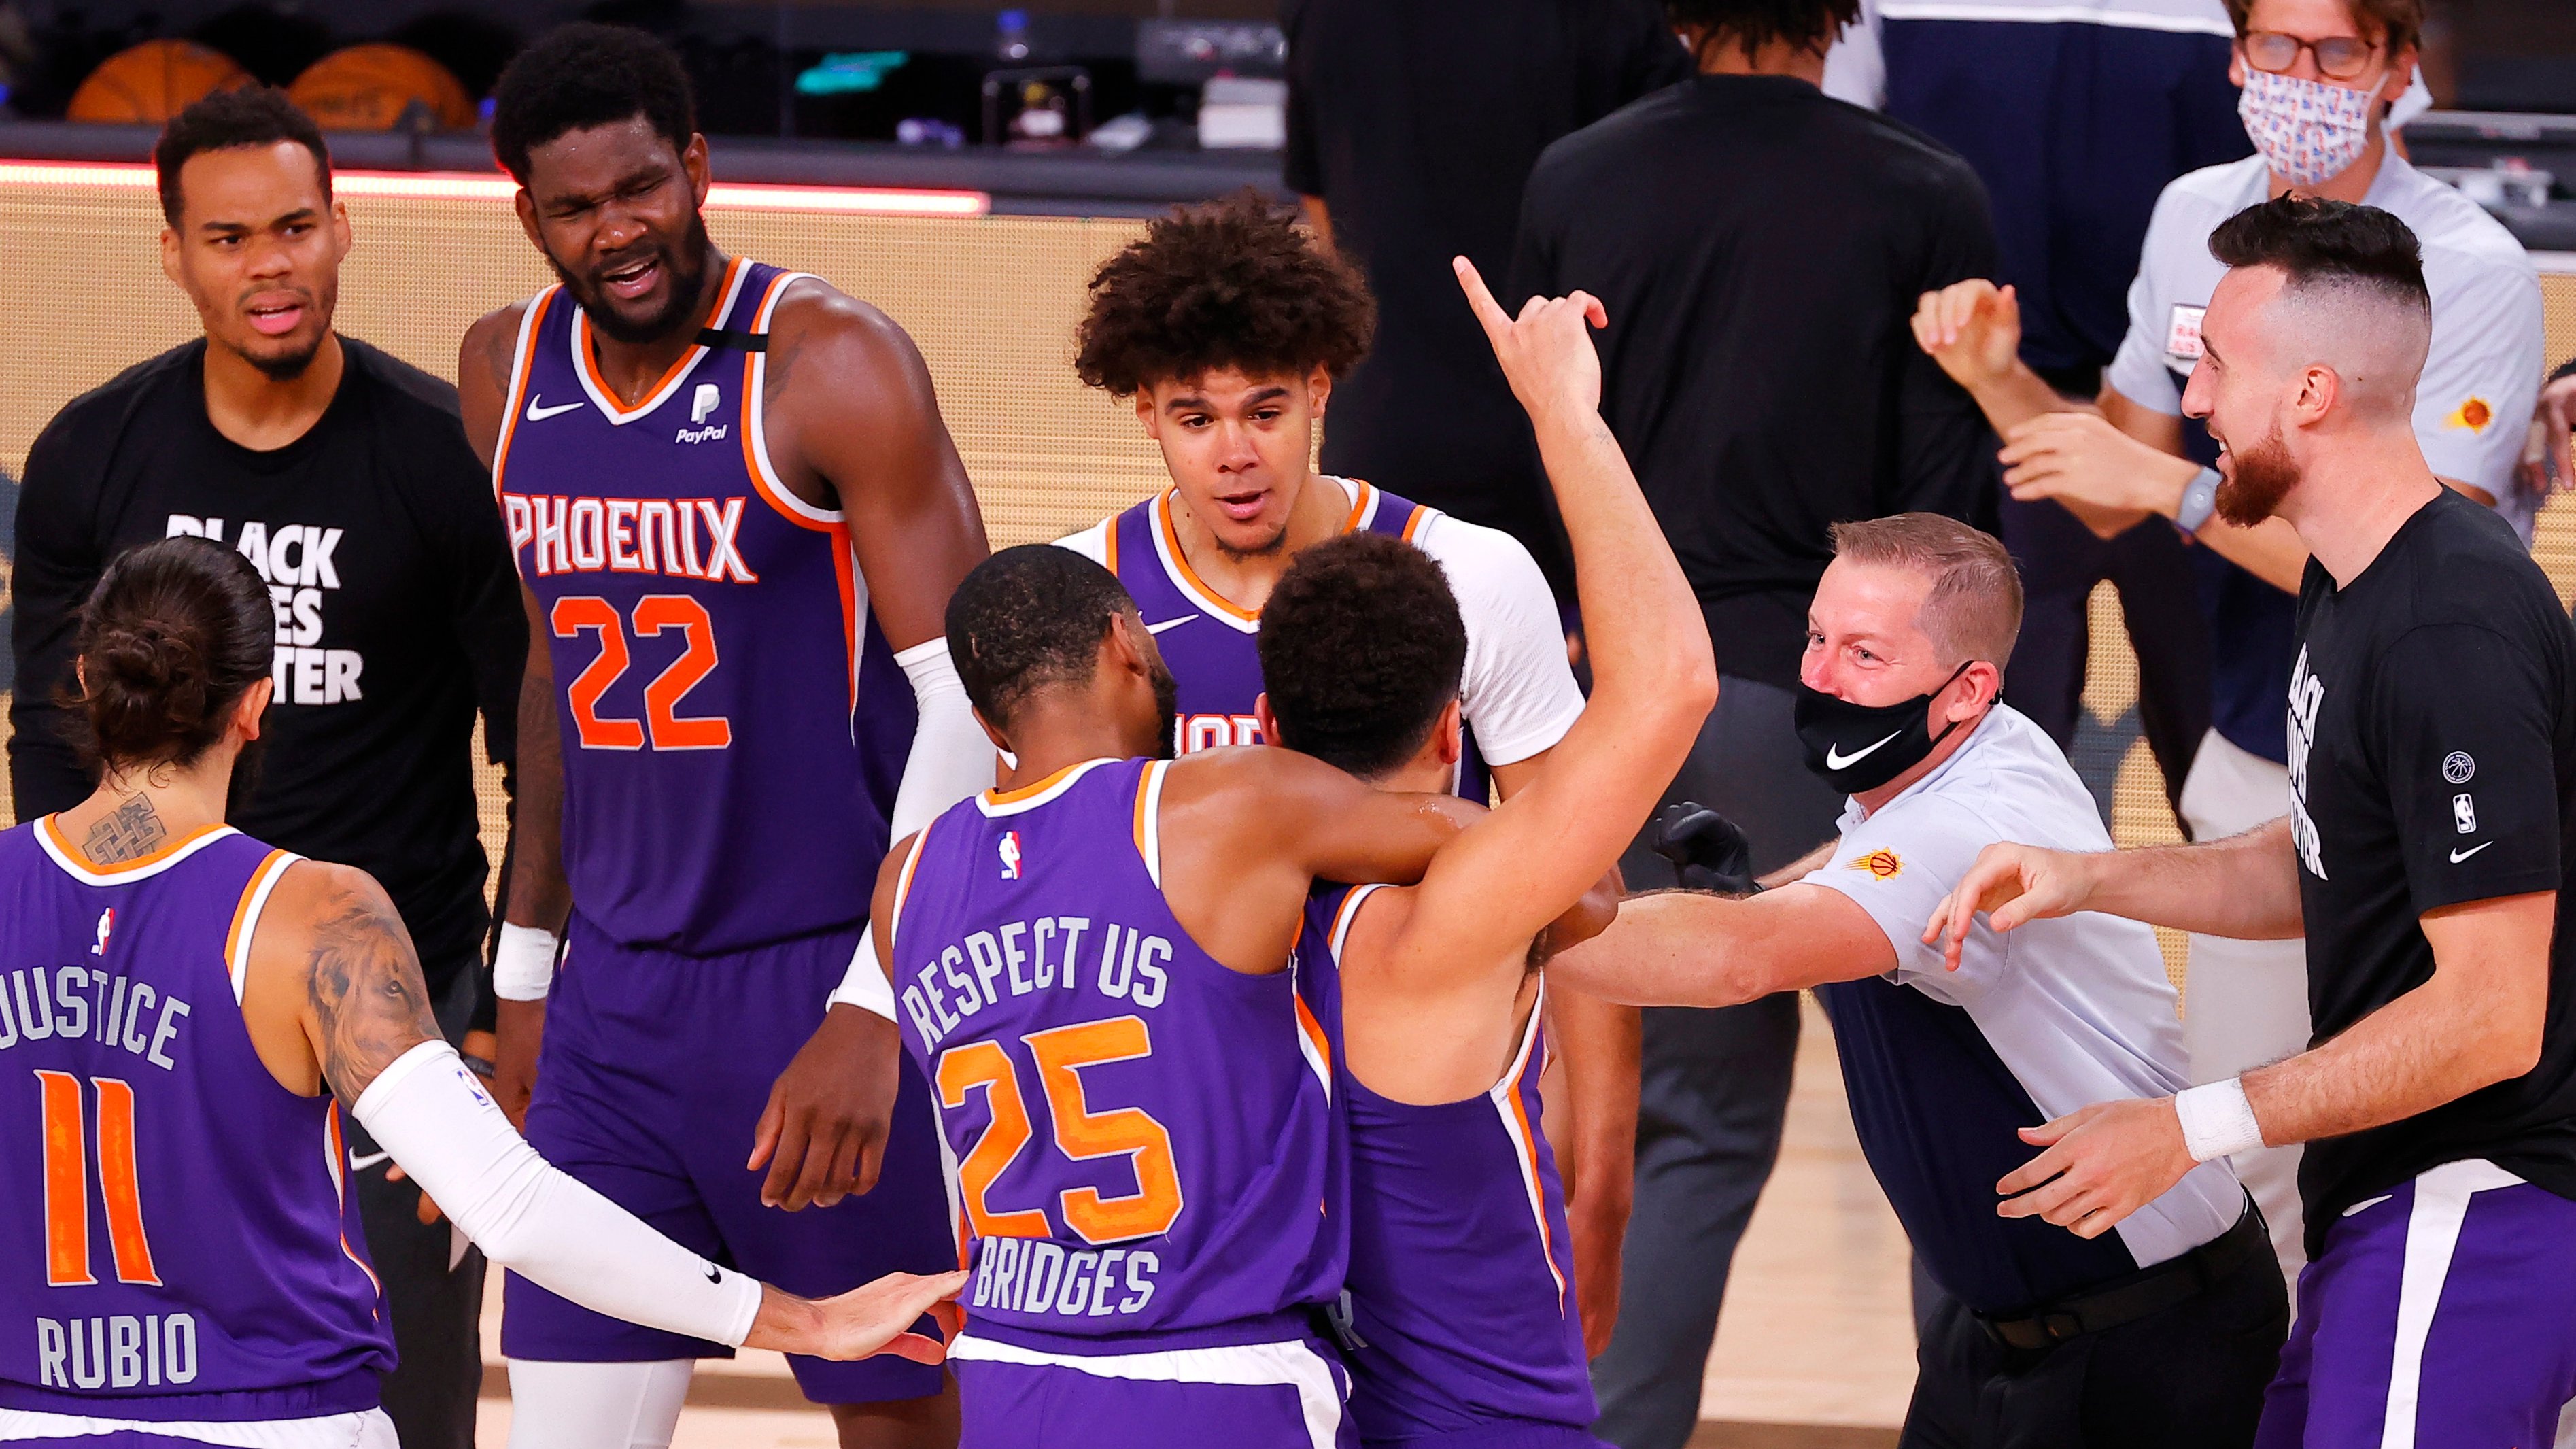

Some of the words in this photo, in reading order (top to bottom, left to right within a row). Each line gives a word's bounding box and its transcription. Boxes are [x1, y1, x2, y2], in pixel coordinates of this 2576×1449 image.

[675, 424, 727, 445] PayPal
[502, 492, 759, 585] PHOENIX
[271, 645, 363, 706] TER
[550, 594, 732, 751] 22
[2288, 641, 2326, 749] BLACK
[2288, 774, 2329, 881] TTER
[0, 966, 191, 1071] JUSTICE
[901, 917, 1090, 1055] RESPECT
[1097, 923, 1174, 1009] US
[33, 1068, 164, 1287] 11
[935, 1015, 1184, 1246] 25
[972, 1235, 1159, 1316] BRIDGES
[36, 1312, 198, 1389] RUBIO
